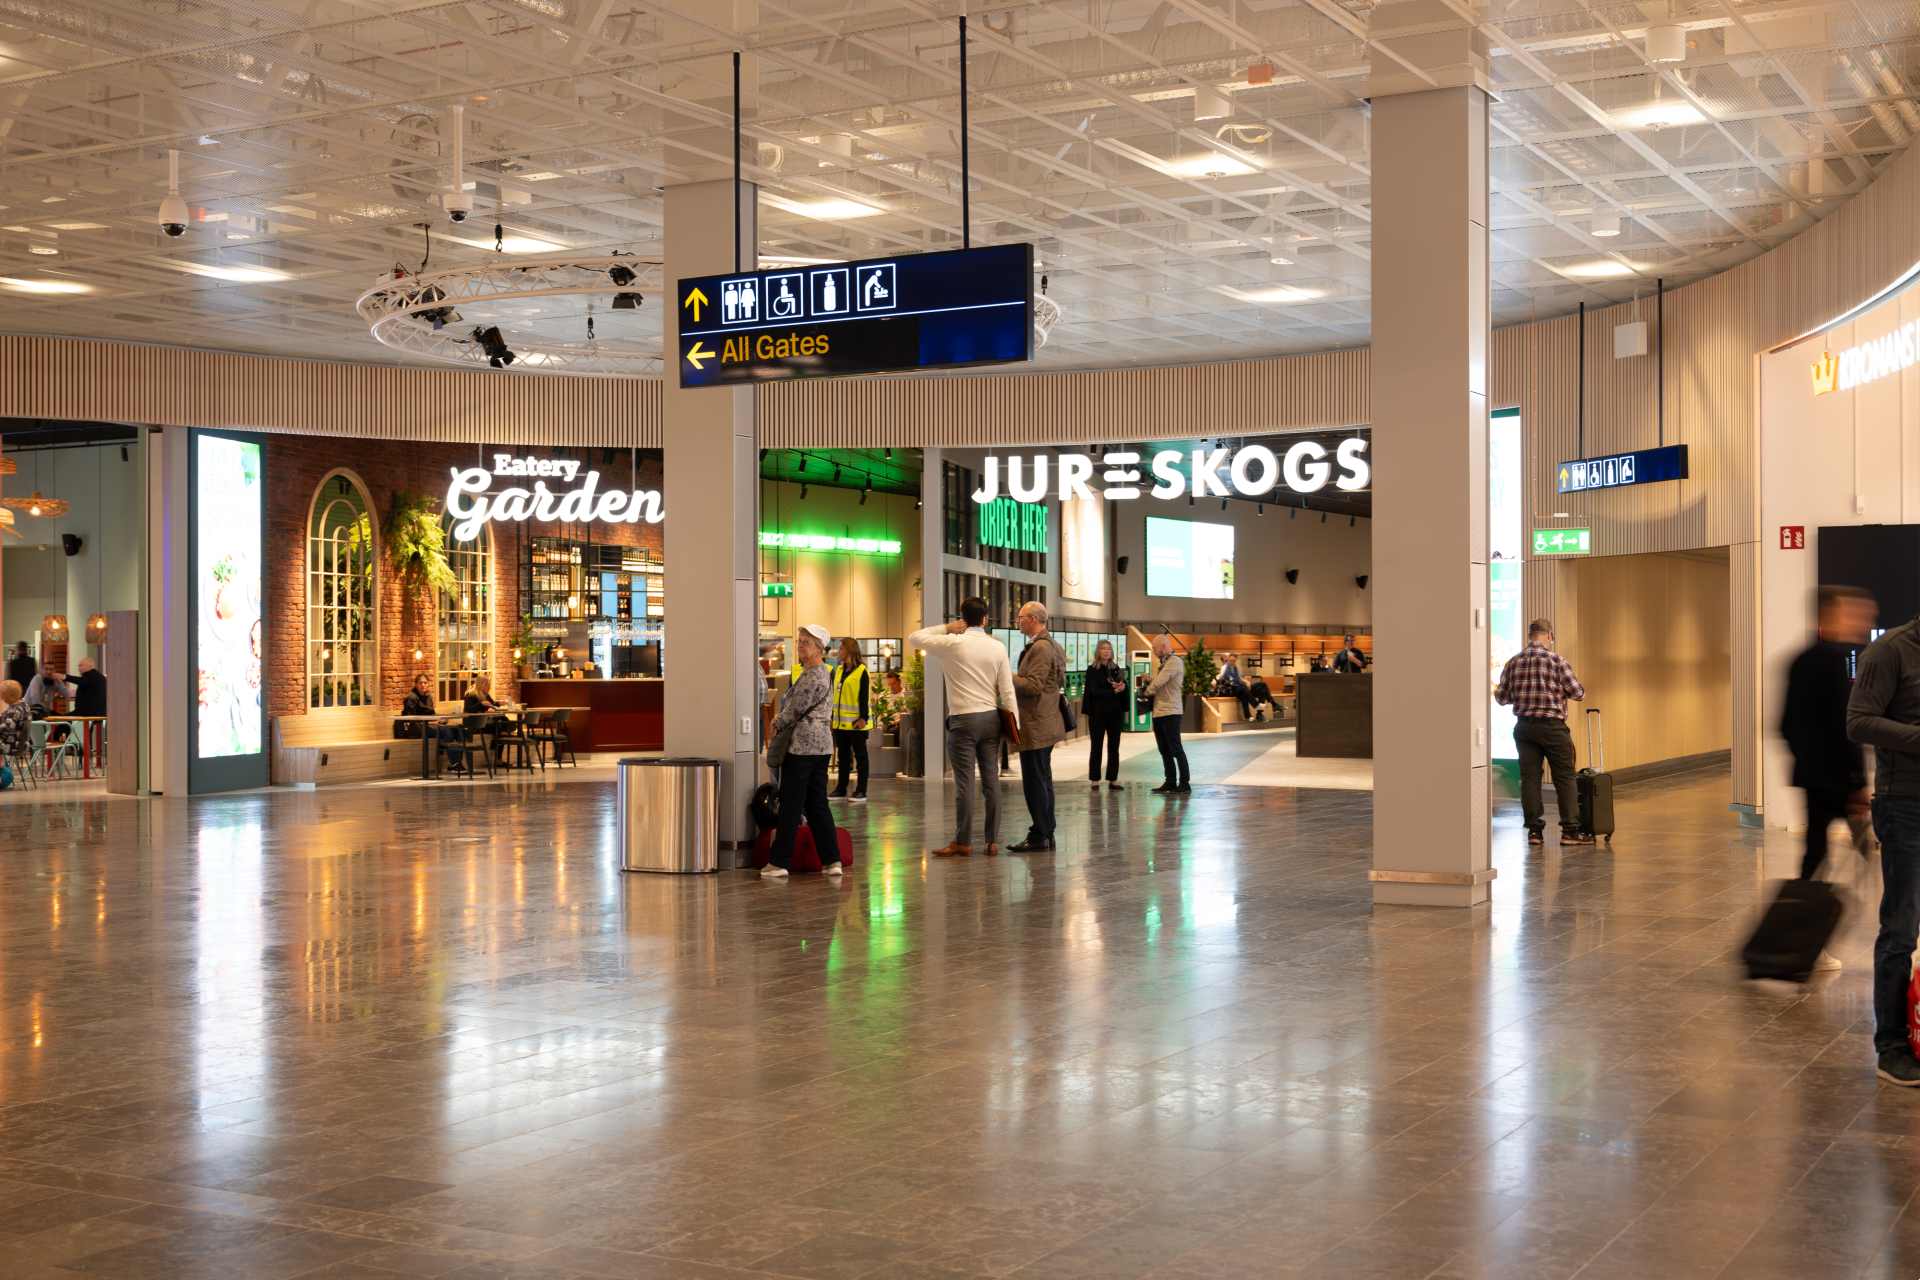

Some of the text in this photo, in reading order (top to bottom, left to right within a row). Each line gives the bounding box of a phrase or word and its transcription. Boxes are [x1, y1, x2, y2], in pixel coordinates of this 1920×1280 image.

[721, 332, 830, 364] All Gates
[1839, 321, 1915, 391] KRONANS
[493, 453, 581, 482] Eatery
[971, 437, 1371, 504] JURESKOGS
[446, 466, 665, 542] Garden
[980, 496, 1048, 553] ORDER HERE
